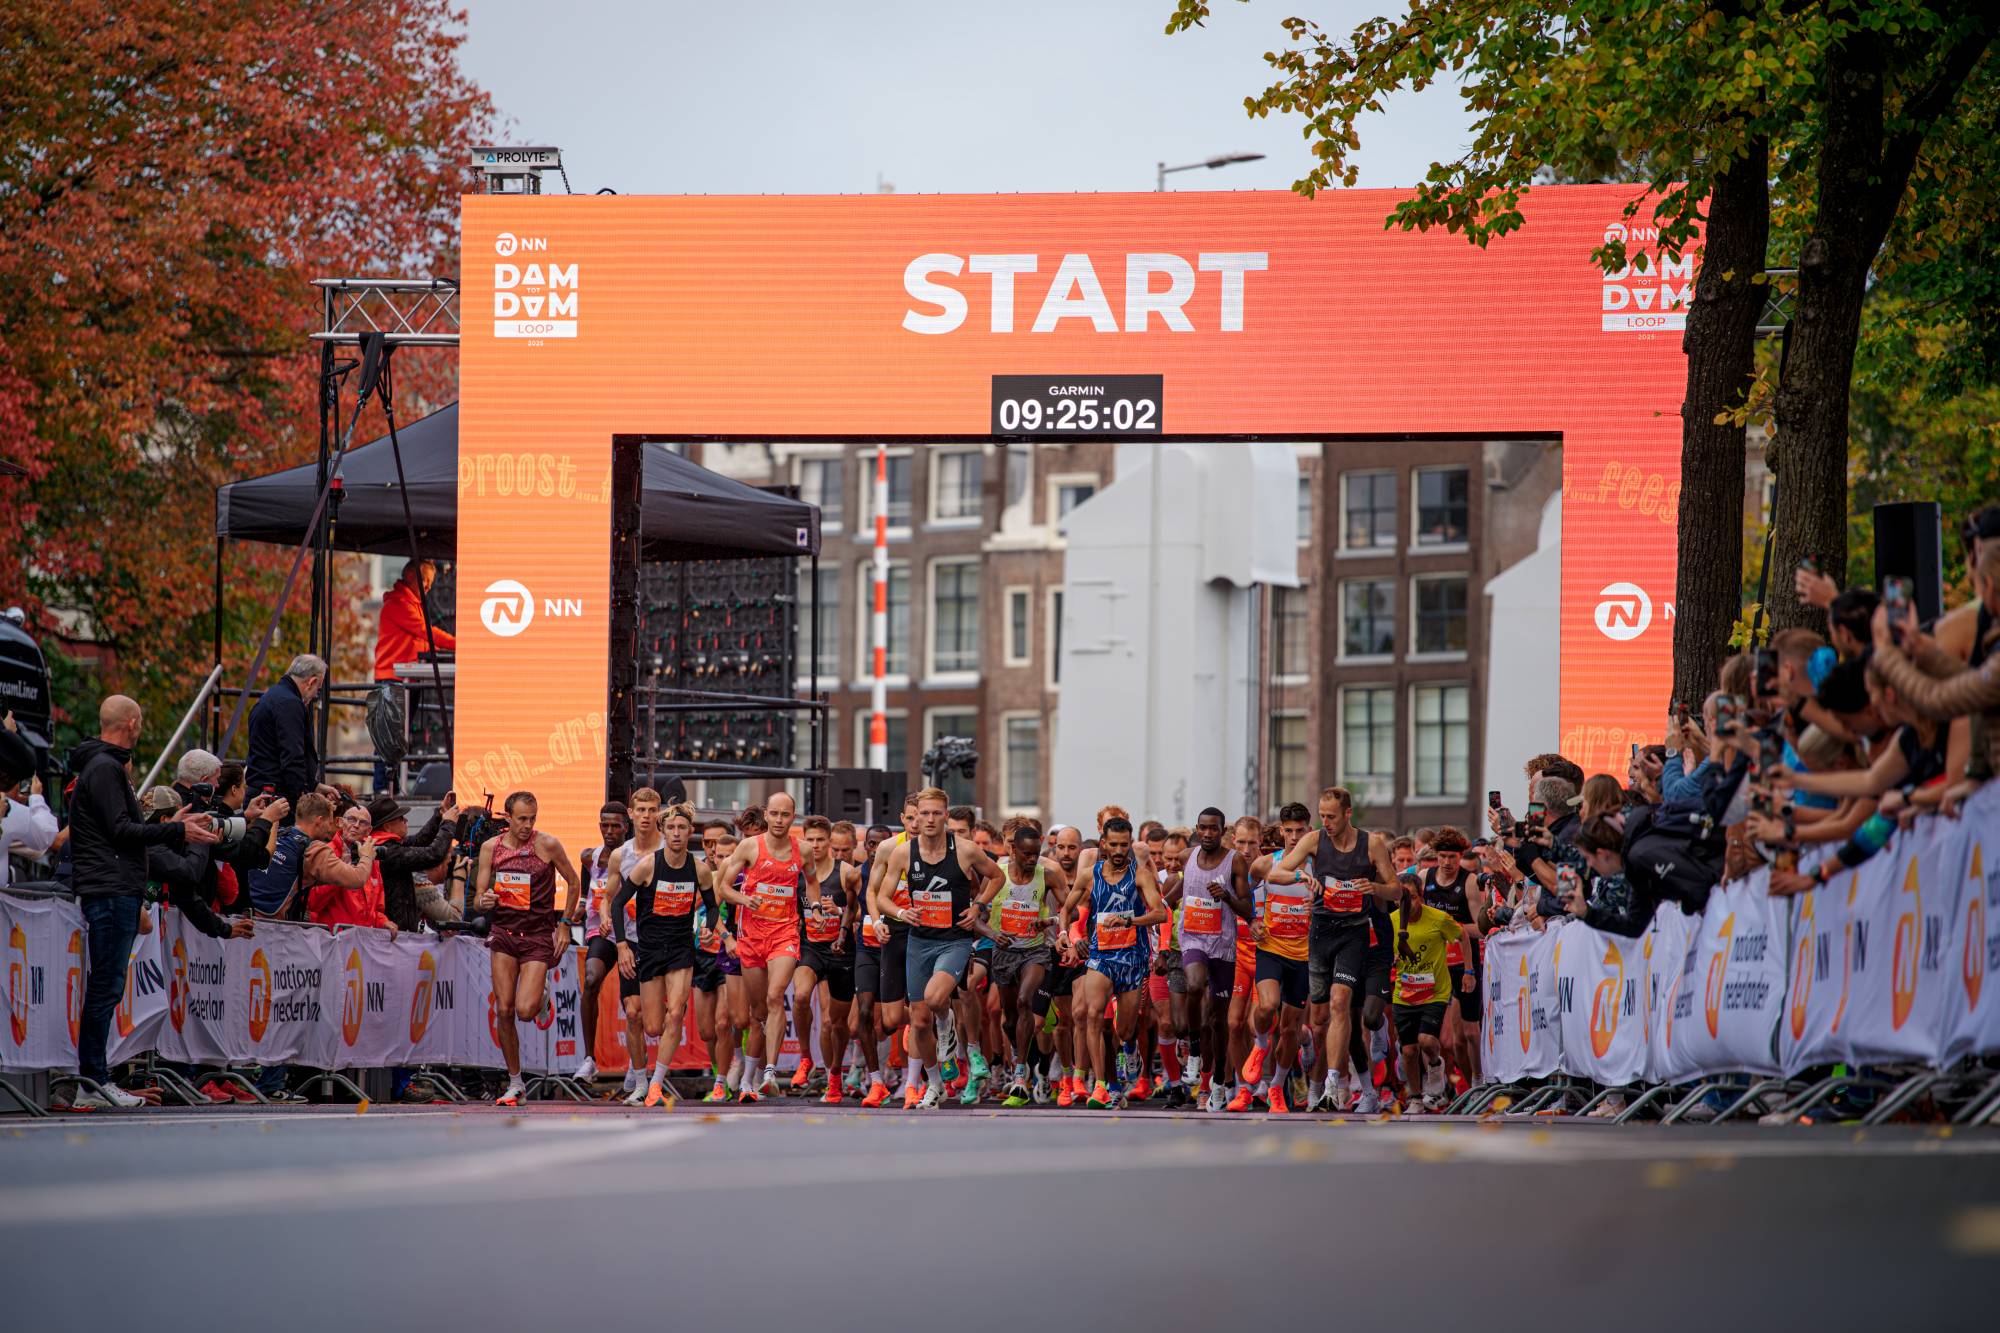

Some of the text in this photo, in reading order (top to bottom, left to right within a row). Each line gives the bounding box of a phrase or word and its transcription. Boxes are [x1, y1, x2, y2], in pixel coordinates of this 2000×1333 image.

[497, 152, 545, 163] PROLYTE
[521, 237, 547, 251] NN
[1632, 228, 1659, 241] NN
[495, 263, 579, 289] DAM
[494, 292, 578, 318] DAM
[901, 252, 1268, 335] START
[1603, 283, 1692, 310] DAM
[518, 324, 554, 334] LOOP
[1628, 317, 1666, 328] LOOP
[1048, 386, 1105, 396] GARMIN
[1000, 399, 1156, 430] 09:25:02
[544, 599, 583, 617] NN
[135, 958, 165, 998] NN
[367, 982, 385, 1013] NN
[435, 980, 453, 1010] NN
